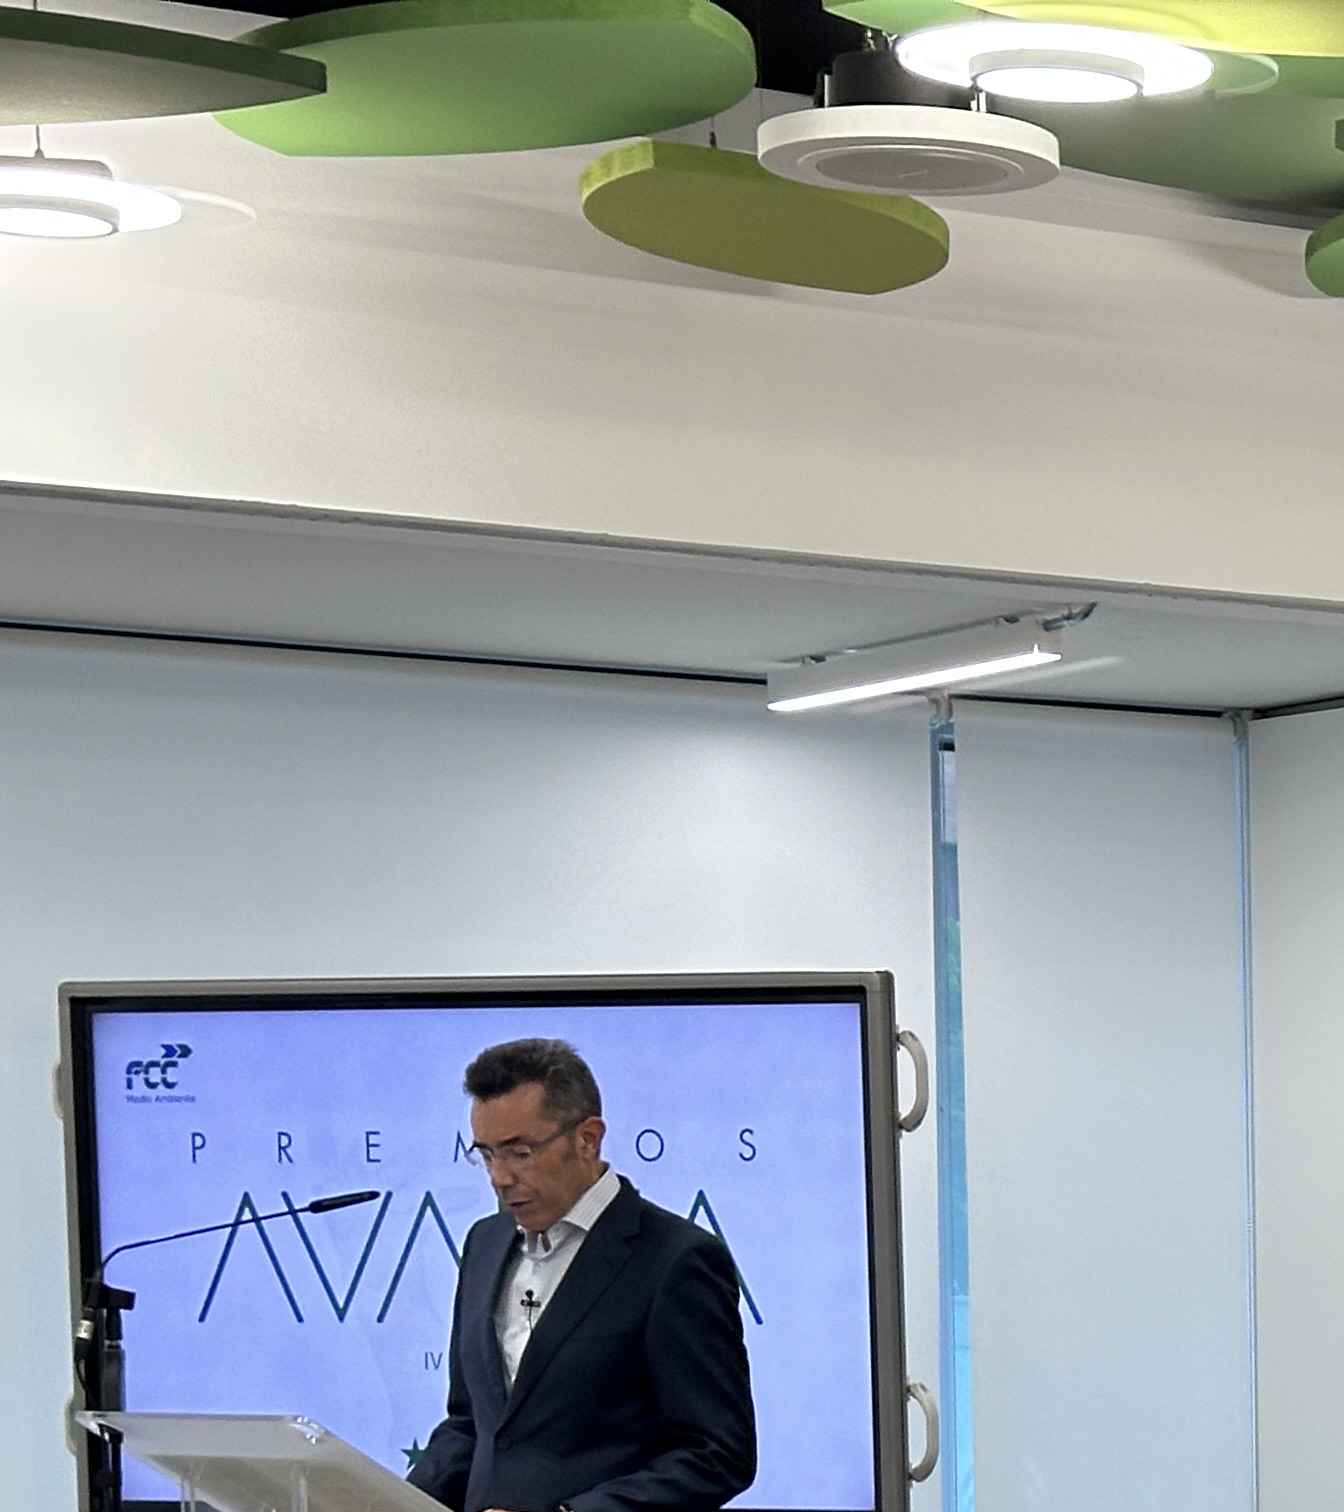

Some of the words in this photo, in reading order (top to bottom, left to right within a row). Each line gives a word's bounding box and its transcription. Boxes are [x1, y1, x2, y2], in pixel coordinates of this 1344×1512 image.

[126, 1060, 179, 1090] FCC
[198, 1189, 763, 1325] AVAA
[424, 1351, 443, 1370] IV
